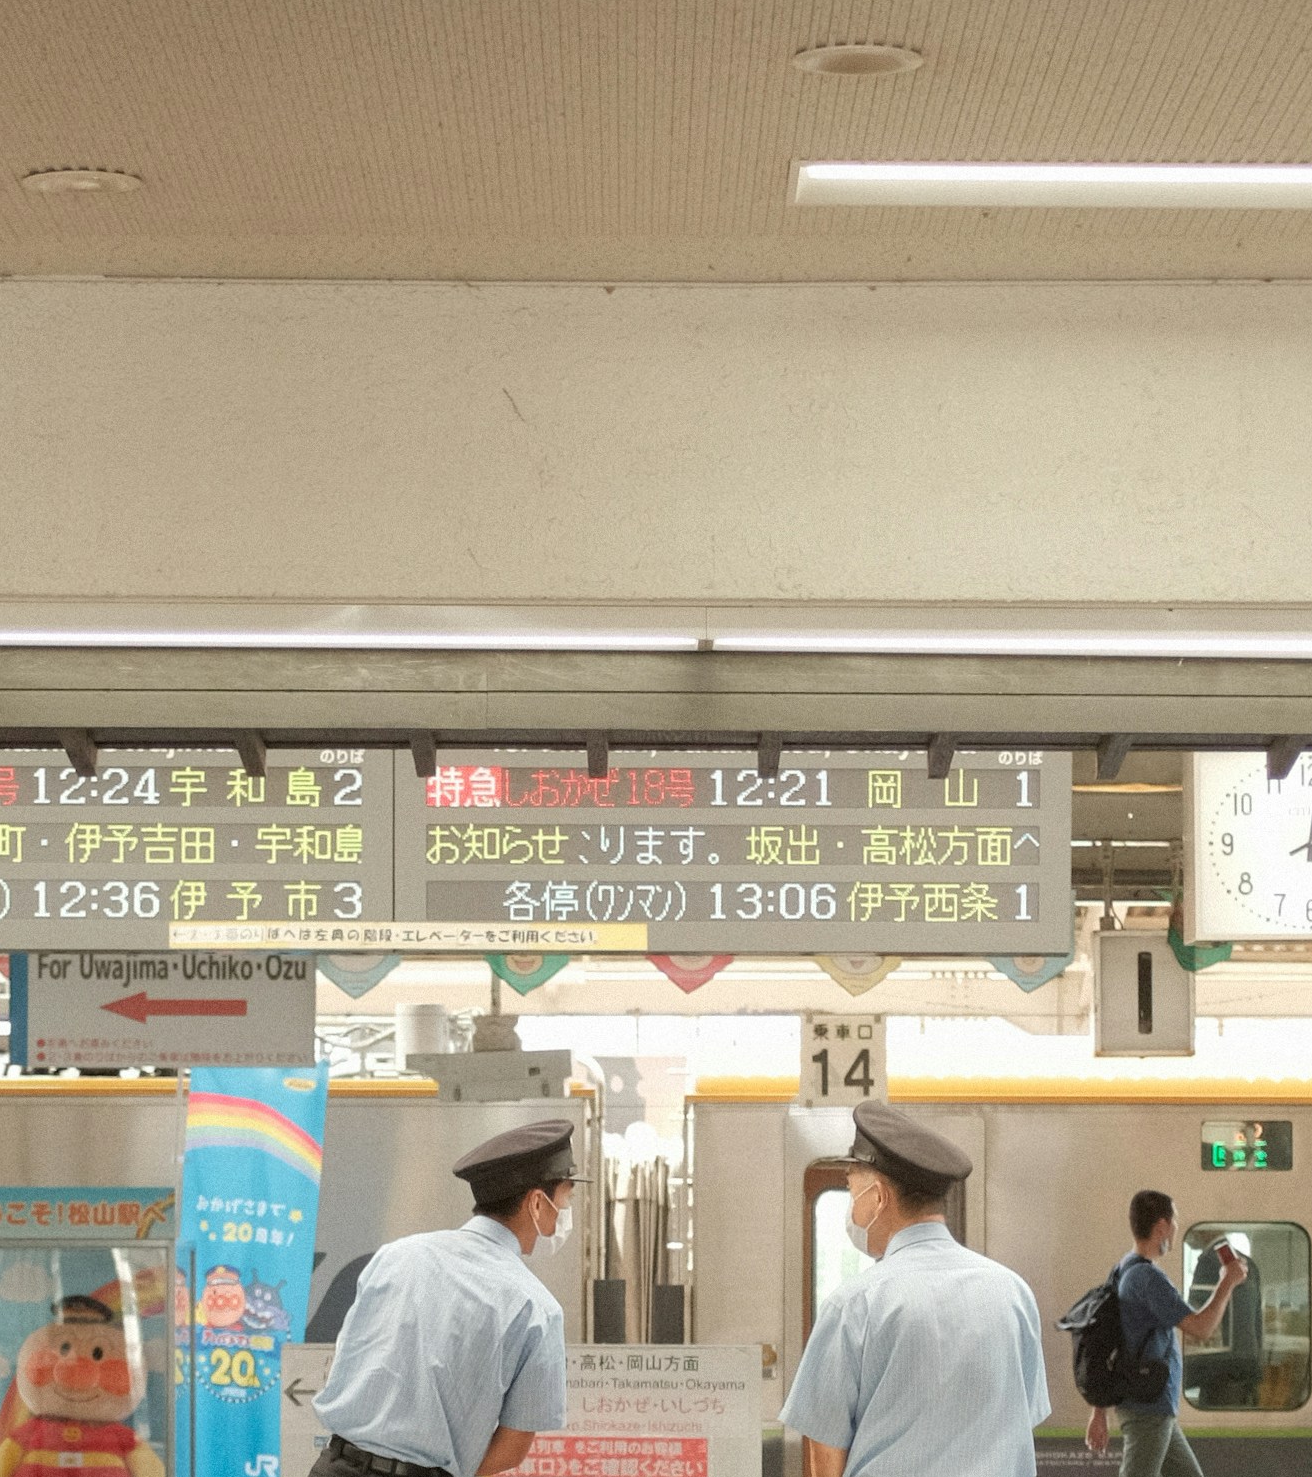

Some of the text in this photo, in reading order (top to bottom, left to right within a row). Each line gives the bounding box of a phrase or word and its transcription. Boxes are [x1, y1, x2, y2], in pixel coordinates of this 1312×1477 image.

[319, 749, 364, 764] のりば
[998, 751, 1043, 766] のりば
[33, 767, 160, 805] 12:24
[170, 766, 322, 807] 宇和島
[333, 767, 363, 805] 2
[710, 769, 832, 806] 12:21
[868, 768, 978, 808] 岡山
[1016, 770, 1033, 806] 1
[1234, 792, 1252, 816] 10
[426, 825, 569, 866] お知らせ
[1221, 832, 1234, 855] 9
[1238, 871, 1253, 895] 8
[33, 880, 160, 919] 12:36
[170, 879, 322, 921] 伊予市
[333, 880, 363, 919] 3
[709, 882, 836, 920] 13:06
[847, 880, 998, 922] 伊予西条
[1015, 882, 1032, 920] 1
[1274, 893, 1286, 917] 7
[37, 954, 71, 980] For
[813, 1023, 873, 1041] 乗車口
[812, 1048, 874, 1097] 14
